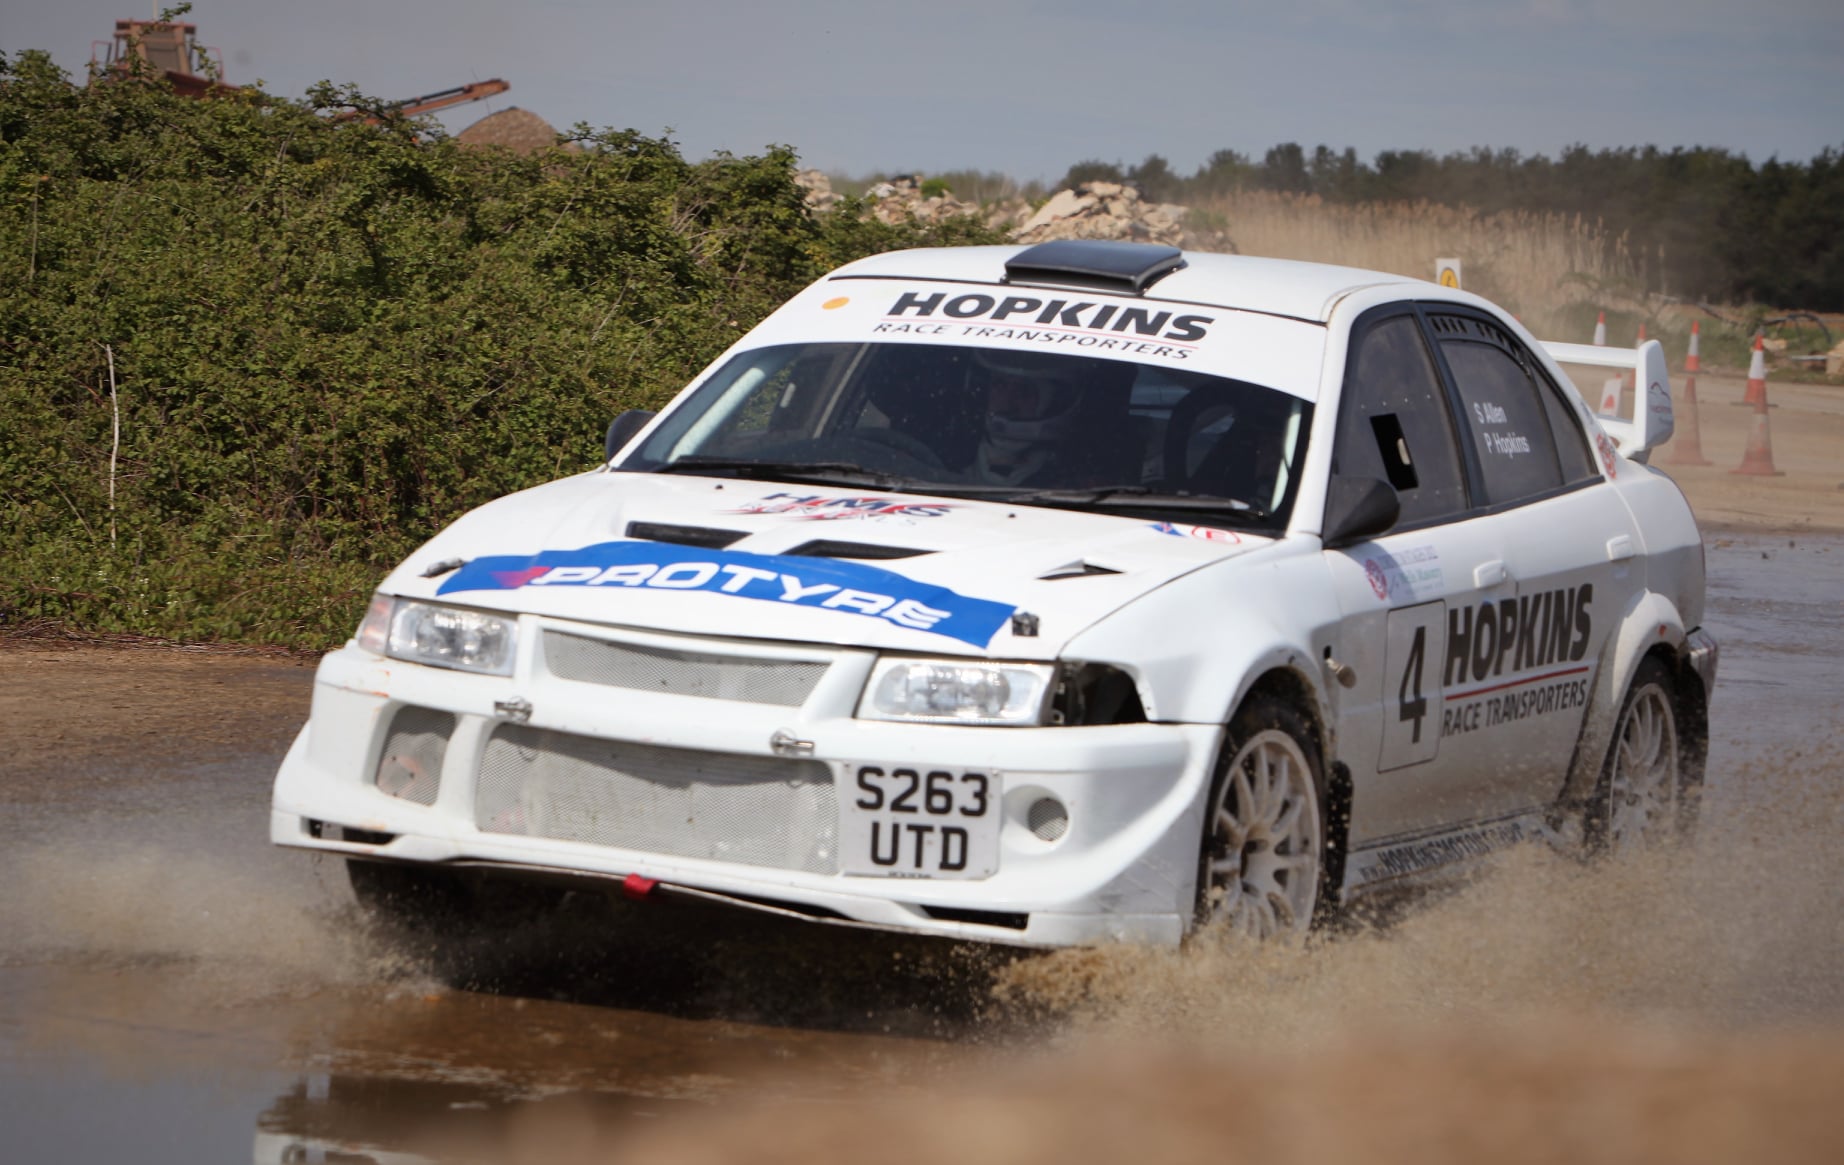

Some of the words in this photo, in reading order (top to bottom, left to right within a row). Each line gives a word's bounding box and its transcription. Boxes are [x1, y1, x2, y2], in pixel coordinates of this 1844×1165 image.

[873, 322, 953, 335] RACE
[962, 325, 1193, 360] TRANSPORTERS
[887, 292, 1215, 341] HOPKINS
[1473, 402, 1484, 424] S
[1483, 432, 1493, 454] P
[1492, 431, 1531, 459] Hopkins
[531, 561, 953, 630] PROTYRE
[1443, 583, 1593, 687] HOPKINS
[1399, 626, 1428, 744] 4
[1441, 702, 1483, 738] RACE
[1485, 679, 1587, 728] TRANSPORTERS
[855, 766, 989, 817] S263
[870, 821, 969, 872] UTD
